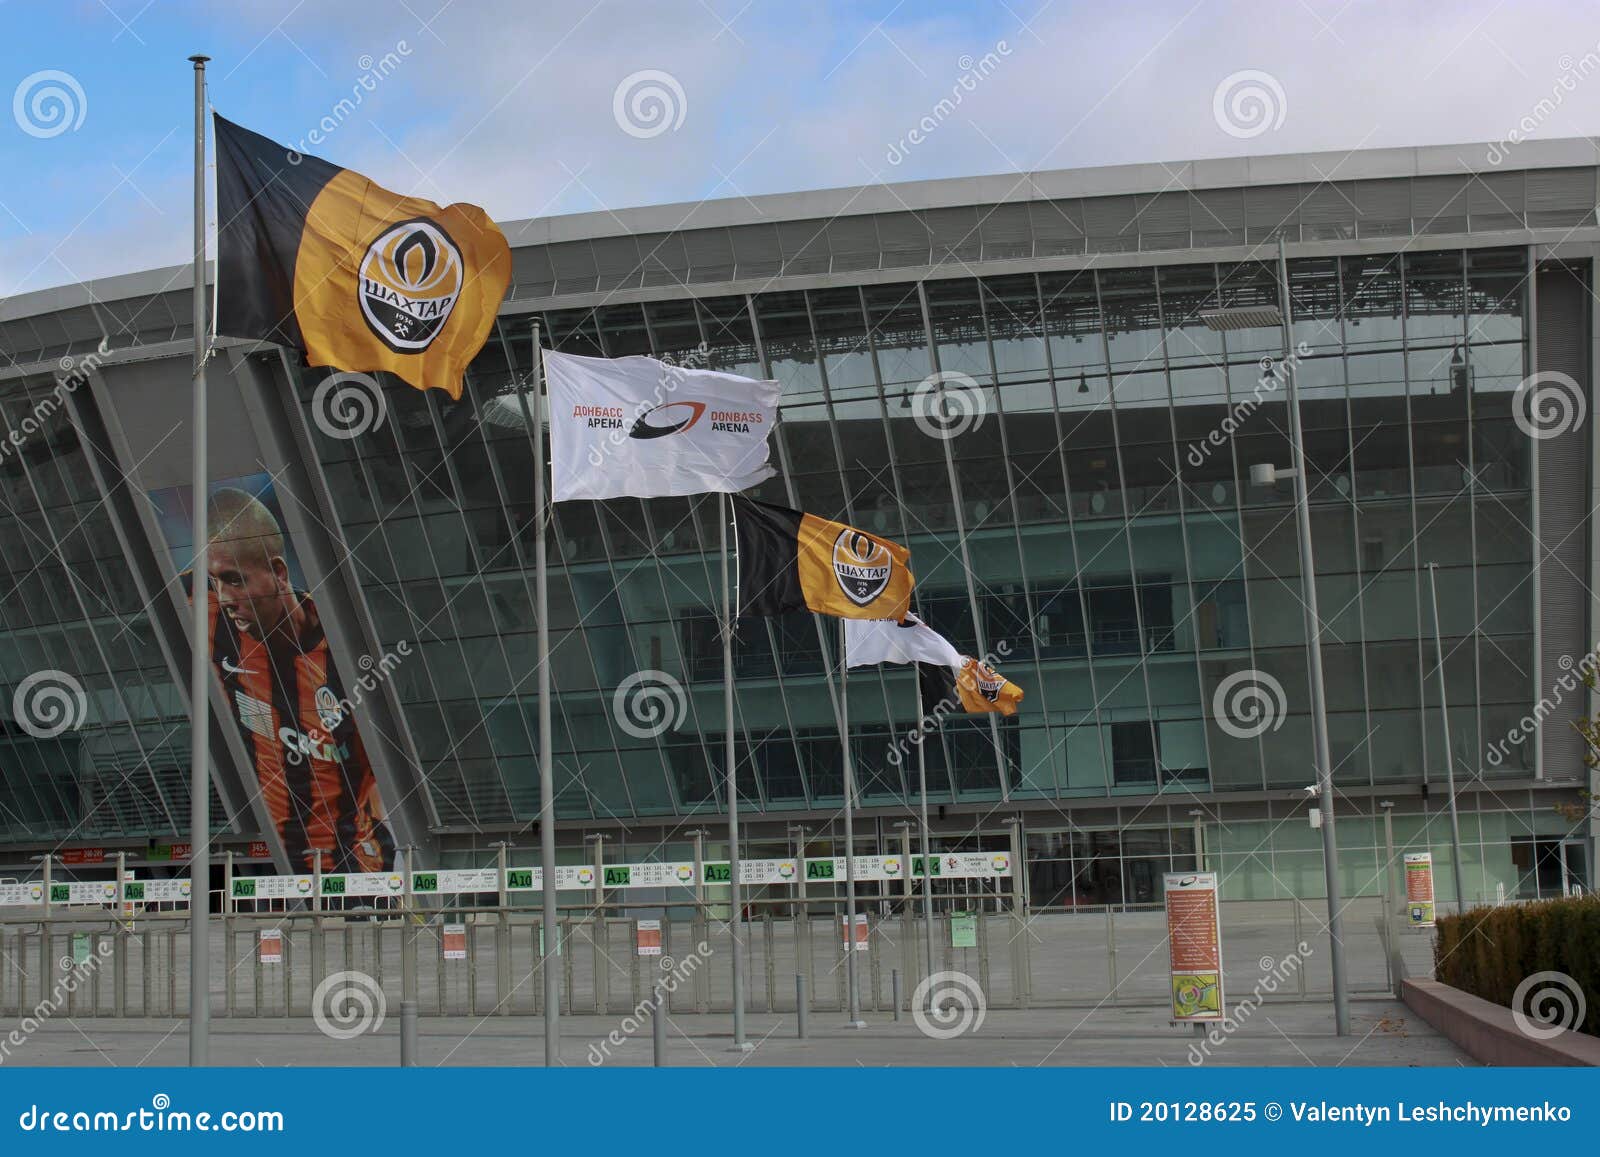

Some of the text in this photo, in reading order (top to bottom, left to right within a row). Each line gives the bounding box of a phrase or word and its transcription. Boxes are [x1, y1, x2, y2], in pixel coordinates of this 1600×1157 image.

[365, 278, 452, 318] ШАХТАР
[394, 312, 414, 327] 1936
[573, 405, 623, 418] ДОНБАСС
[711, 411, 764, 424] DONBASS
[587, 417, 624, 429] АРЕНА
[711, 422, 750, 433] ARENA
[837, 563, 888, 578] ШАХТАР
[605, 868, 630, 884] A11
[705, 864, 730, 881] A12
[808, 862, 833, 878] A13
[233, 880, 255, 896] A07
[322, 877, 345, 893] A08
[414, 875, 437, 891] A09
[508, 872, 532, 888] A10
[52, 886, 70, 901] A05
[124, 883, 144, 899] A06
